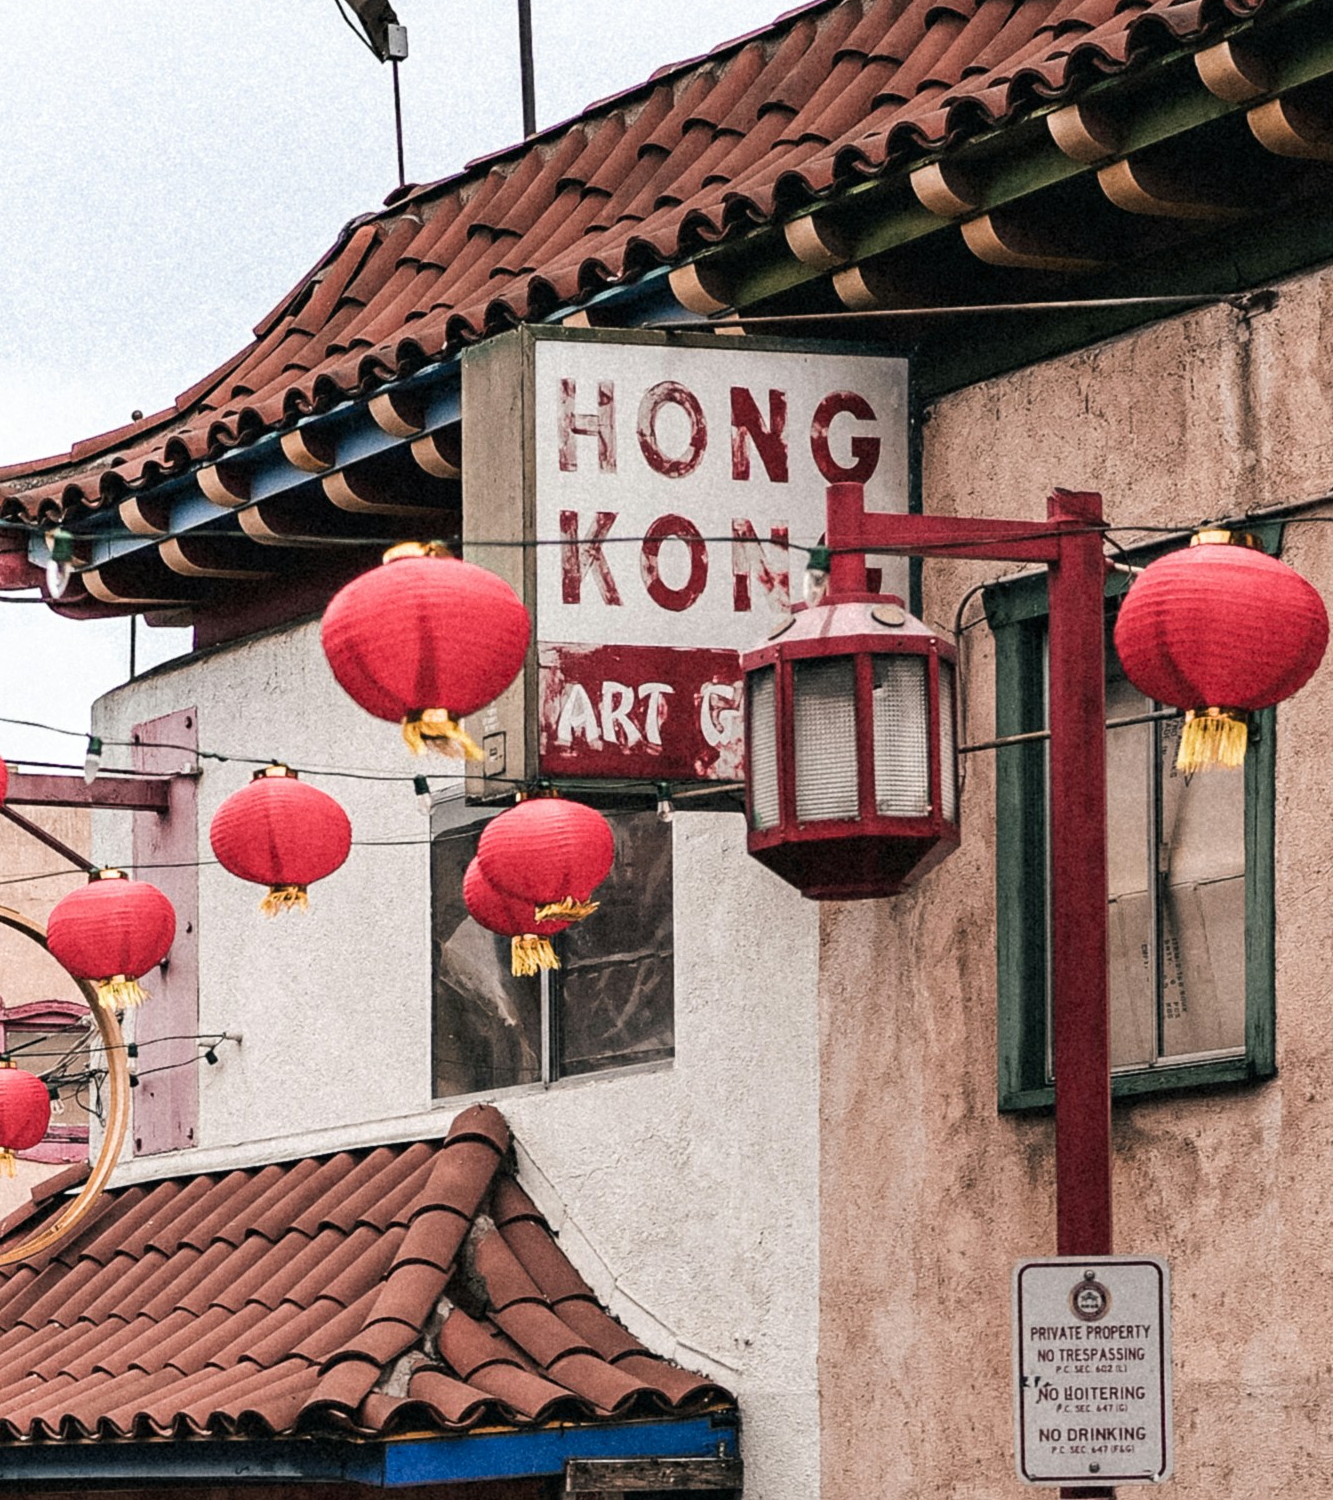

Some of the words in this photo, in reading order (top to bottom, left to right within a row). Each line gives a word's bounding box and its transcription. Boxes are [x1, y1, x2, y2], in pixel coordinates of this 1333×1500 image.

[557, 377, 881, 485] HONG
[556, 680, 674, 755] ART
[1030, 1326, 1083, 1340] PRIVATE
[1086, 1324, 1151, 1339] PROPERTY
[1037, 1349, 1055, 1362] NO
[1059, 1347, 1145, 1361] TRESPASSING
[1095, 1364, 1113, 1372] 602
[1038, 1386, 1059, 1401] NO
[1064, 1386, 1146, 1400] LOITERING
[1096, 1403, 1113, 1412] 647
[1039, 1428, 1061, 1442] NO
[1067, 1426, 1147, 1441] DRINKING
[1091, 1445, 1108, 1454] 647
